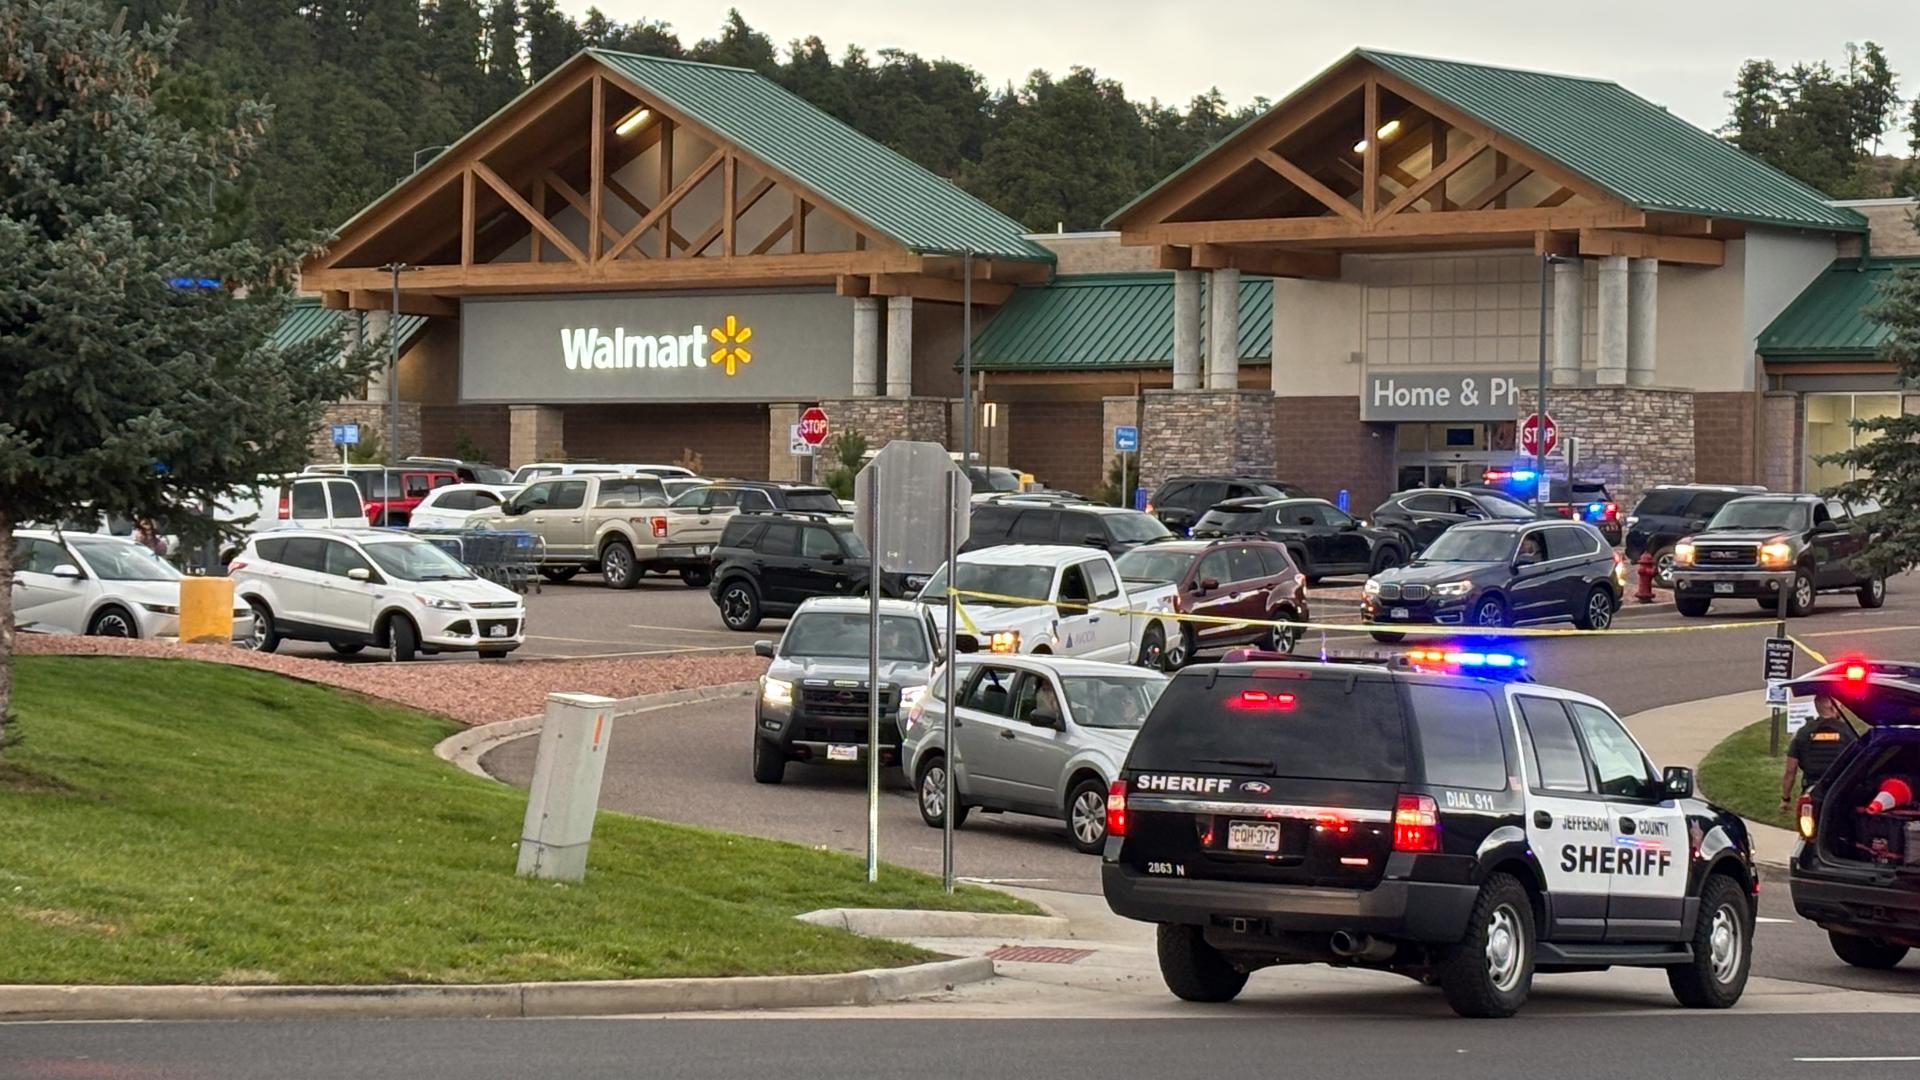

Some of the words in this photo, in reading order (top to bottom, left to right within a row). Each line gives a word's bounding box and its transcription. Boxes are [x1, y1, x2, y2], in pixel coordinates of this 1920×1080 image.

[560, 325, 708, 370] Walmart
[1374, 379, 1450, 407] Home
[1460, 378, 1479, 406] &
[802, 419, 827, 434] STOP
[1710, 551, 1739, 559] GMC
[1136, 775, 1232, 793] SHERIFF
[1446, 791, 1473, 809] DIAL
[1475, 794, 1494, 810] 911
[1562, 814, 1609, 832] JEFFERSON
[1639, 821, 1669, 836] COUNTY
[1148, 862, 1172, 874] 2863
[1176, 865, 1185, 876] N
[1560, 844, 1671, 876] SHERIFF
